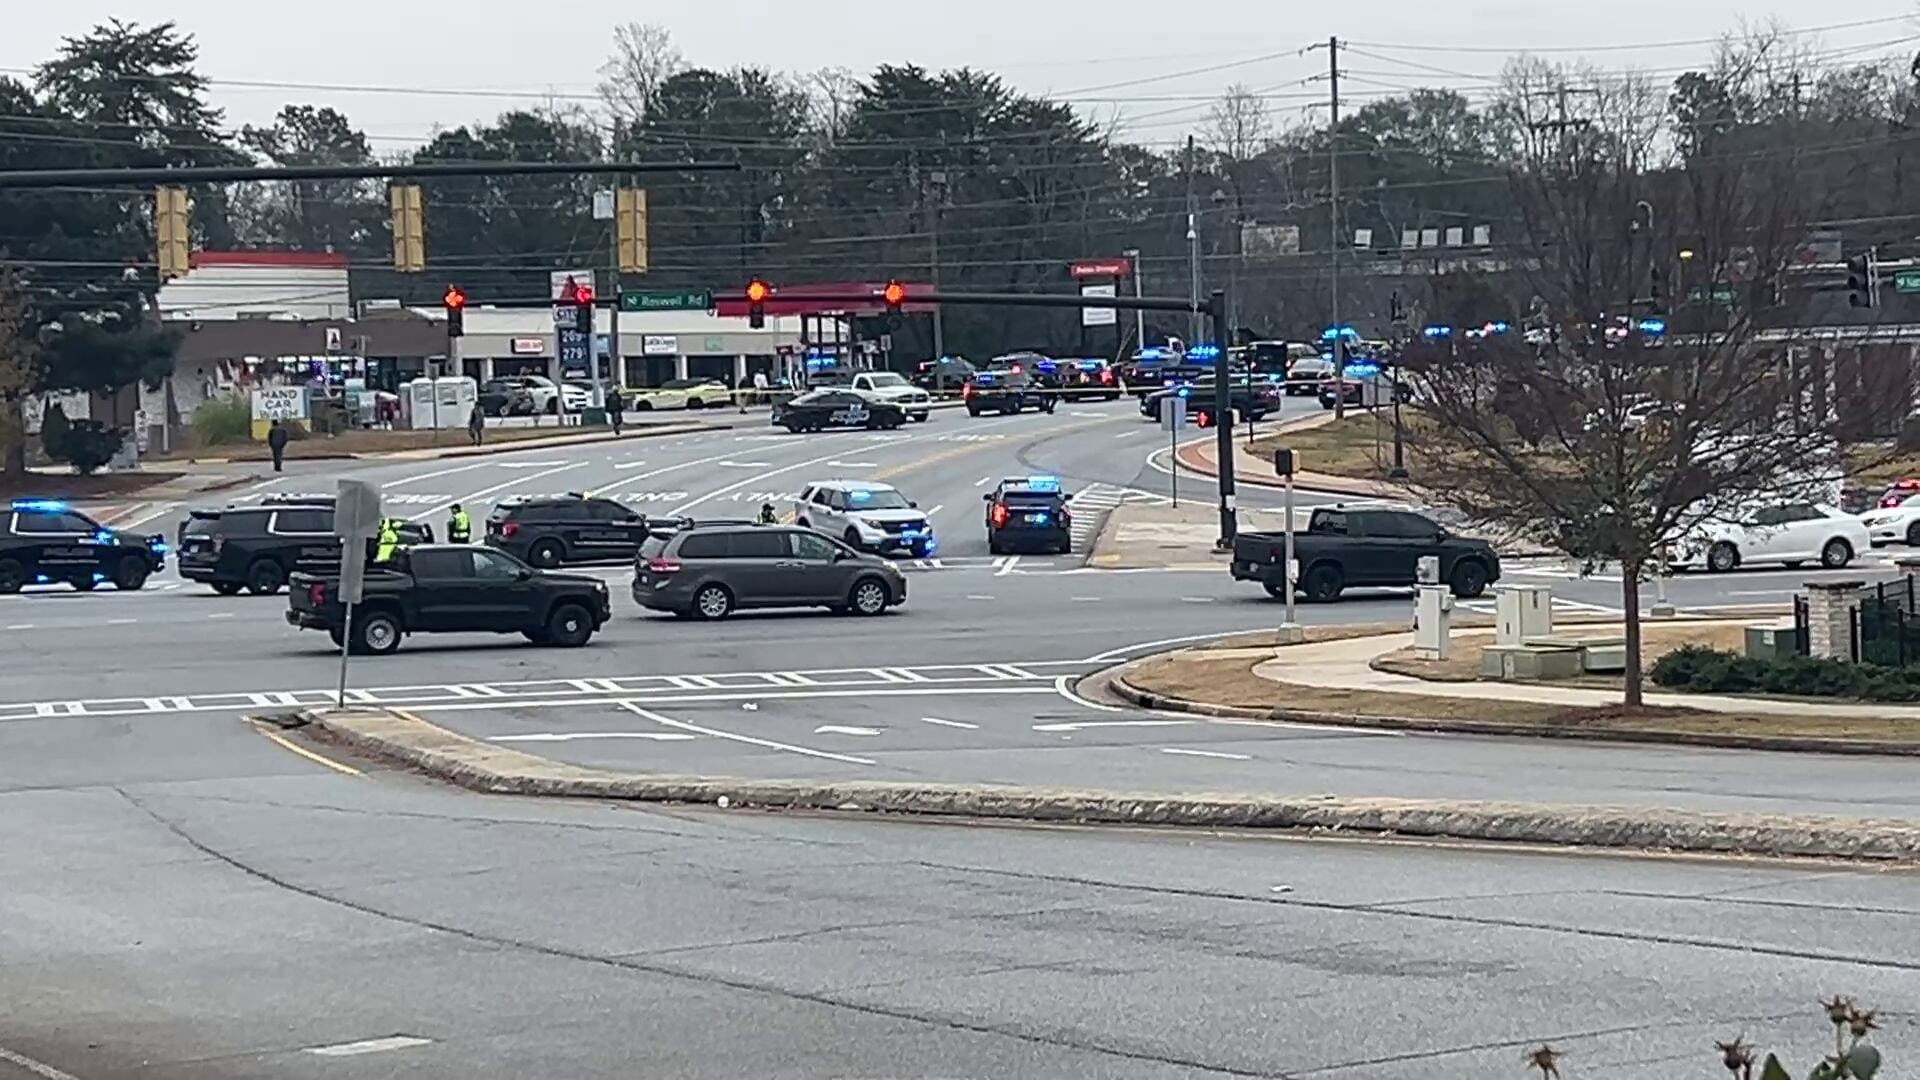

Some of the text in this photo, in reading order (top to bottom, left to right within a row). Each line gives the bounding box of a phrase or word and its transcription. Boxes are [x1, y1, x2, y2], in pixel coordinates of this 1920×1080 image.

[641, 295, 683, 306] Roswell
[687, 294, 704, 306] Rd
[260, 389, 298, 399] HAND
[265, 399, 292, 409] CAR
[259, 409, 299, 418] WASH
